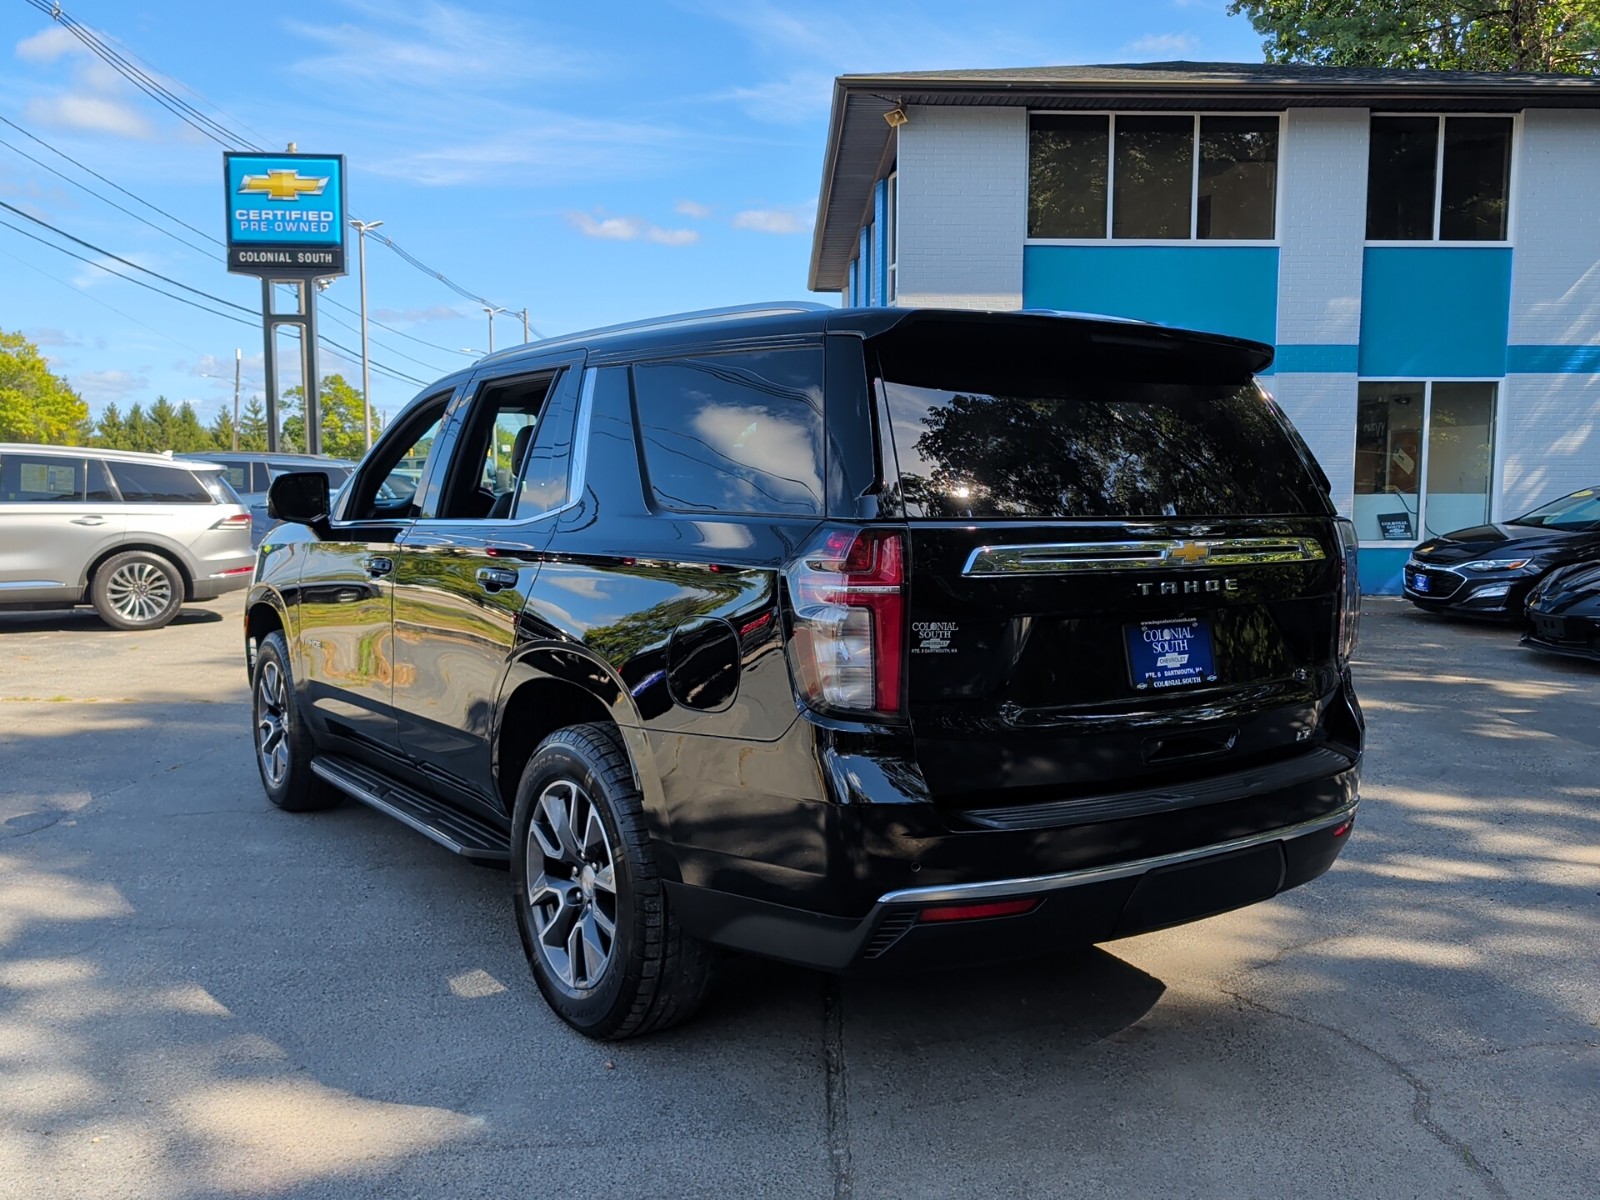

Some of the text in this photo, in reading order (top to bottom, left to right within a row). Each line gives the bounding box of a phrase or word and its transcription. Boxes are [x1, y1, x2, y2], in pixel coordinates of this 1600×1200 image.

[235, 209, 334, 222] CERTIFIED
[240, 221, 330, 233] PRE-OWNED
[239, 251, 332, 264] COLONIAL SOUTH
[1136, 579, 1239, 596] TAHOE
[911, 622, 959, 631] COLONIAL
[919, 630, 951, 639] SOUTH
[1143, 627, 1194, 642] COLONIAL
[1152, 639, 1188, 654] SOUTH
[1159, 656, 1186, 665] CHEVROLET
[1182, 676, 1202, 685] SOUTH
